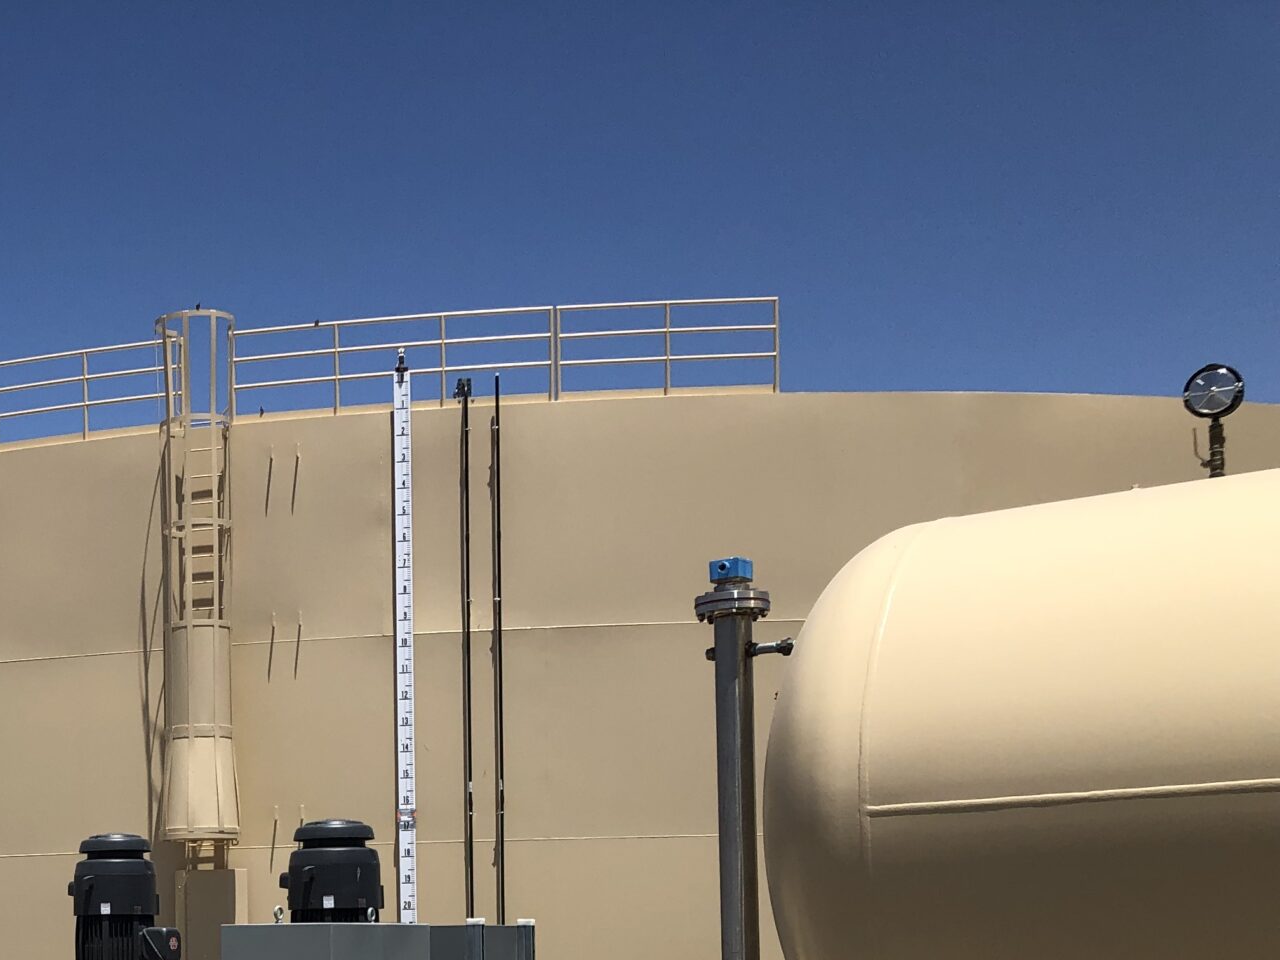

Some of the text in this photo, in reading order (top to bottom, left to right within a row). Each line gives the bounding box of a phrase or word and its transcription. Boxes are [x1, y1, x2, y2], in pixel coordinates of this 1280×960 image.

[401, 637, 408, 646] 10
[401, 664, 408, 673] 11
[401, 690, 409, 699] 12
[401, 716, 409, 725] 13
[401, 743, 409, 752] 14
[402, 769, 410, 778] 15
[402, 795, 410, 804] 16
[404, 874, 411, 883] 19
[403, 900, 412, 909] 20
